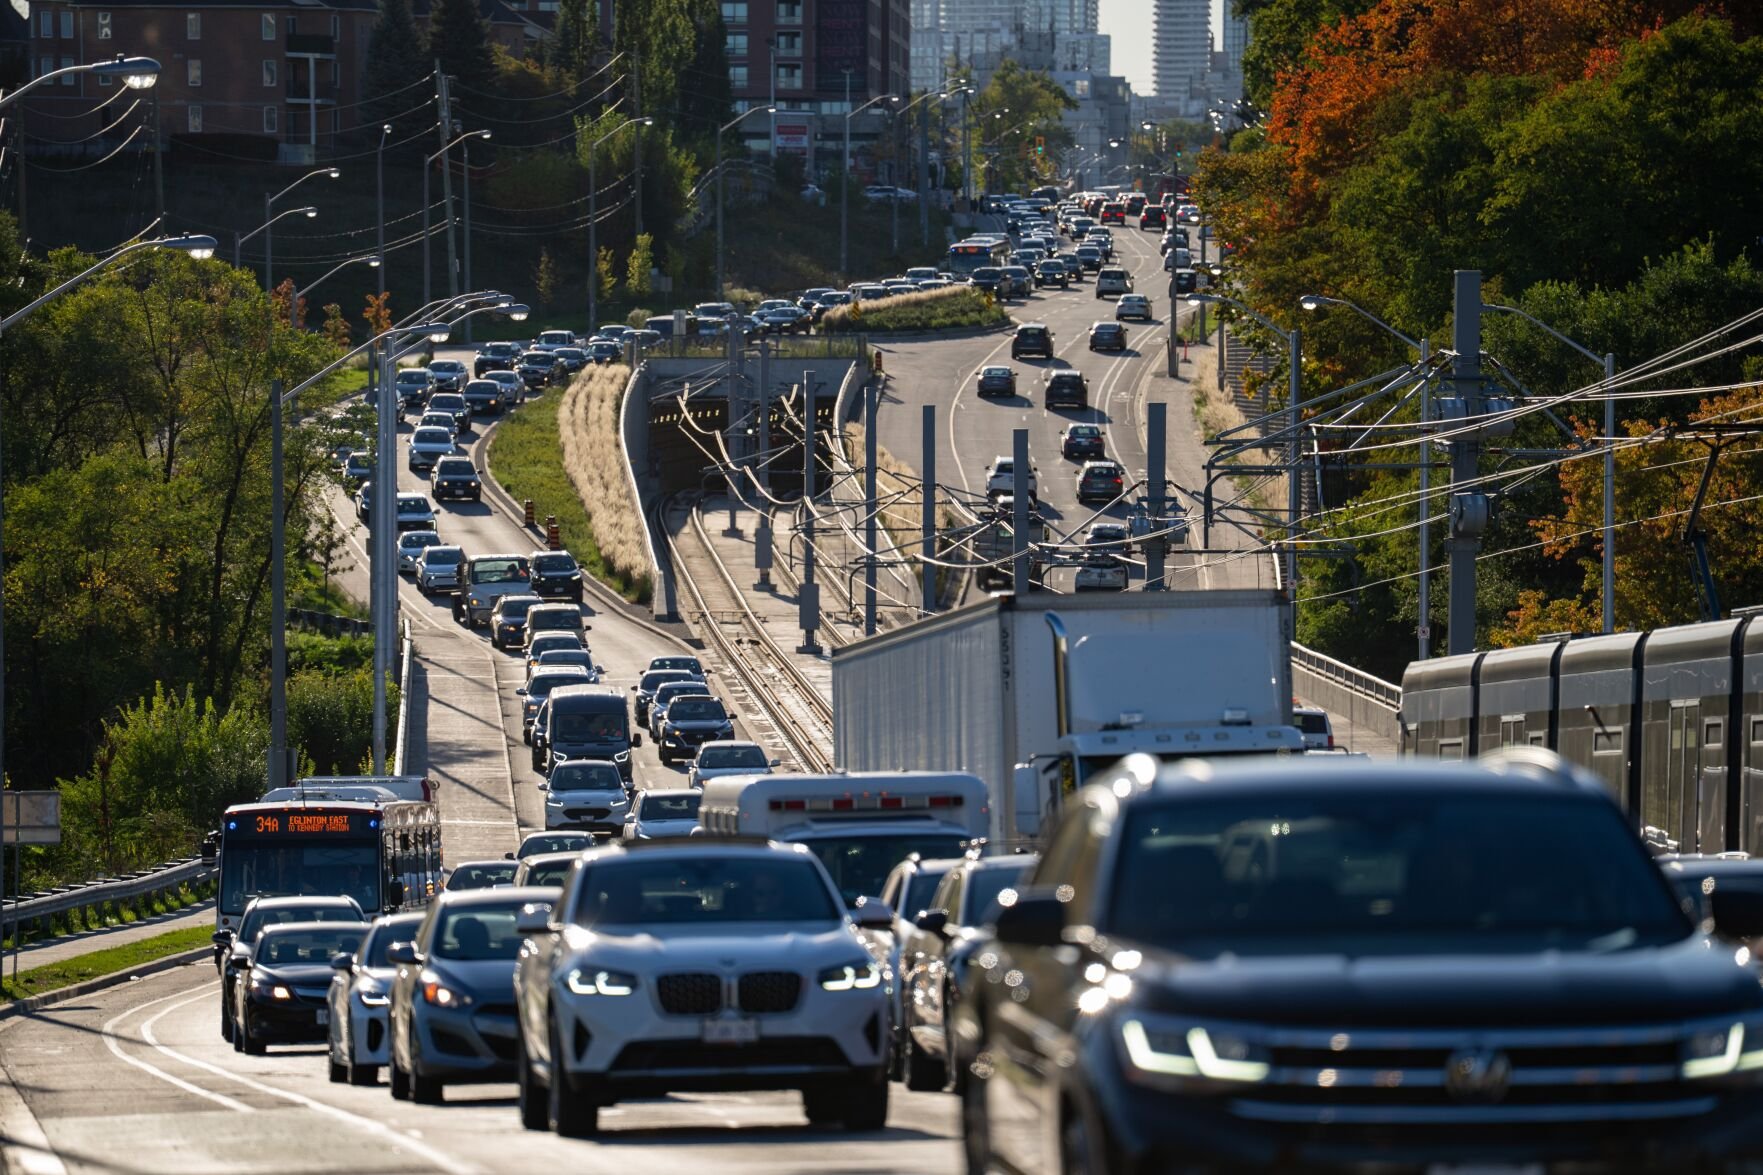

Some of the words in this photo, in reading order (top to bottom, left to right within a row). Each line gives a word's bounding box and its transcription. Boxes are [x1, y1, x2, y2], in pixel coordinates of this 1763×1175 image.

[256, 816, 279, 832] 34A
[289, 815, 327, 824] EGLINTON
[329, 815, 349, 824] EAST
[288, 824, 296, 832] TO
[297, 824, 324, 832] KENNEDY
[326, 824, 350, 832] STATION
